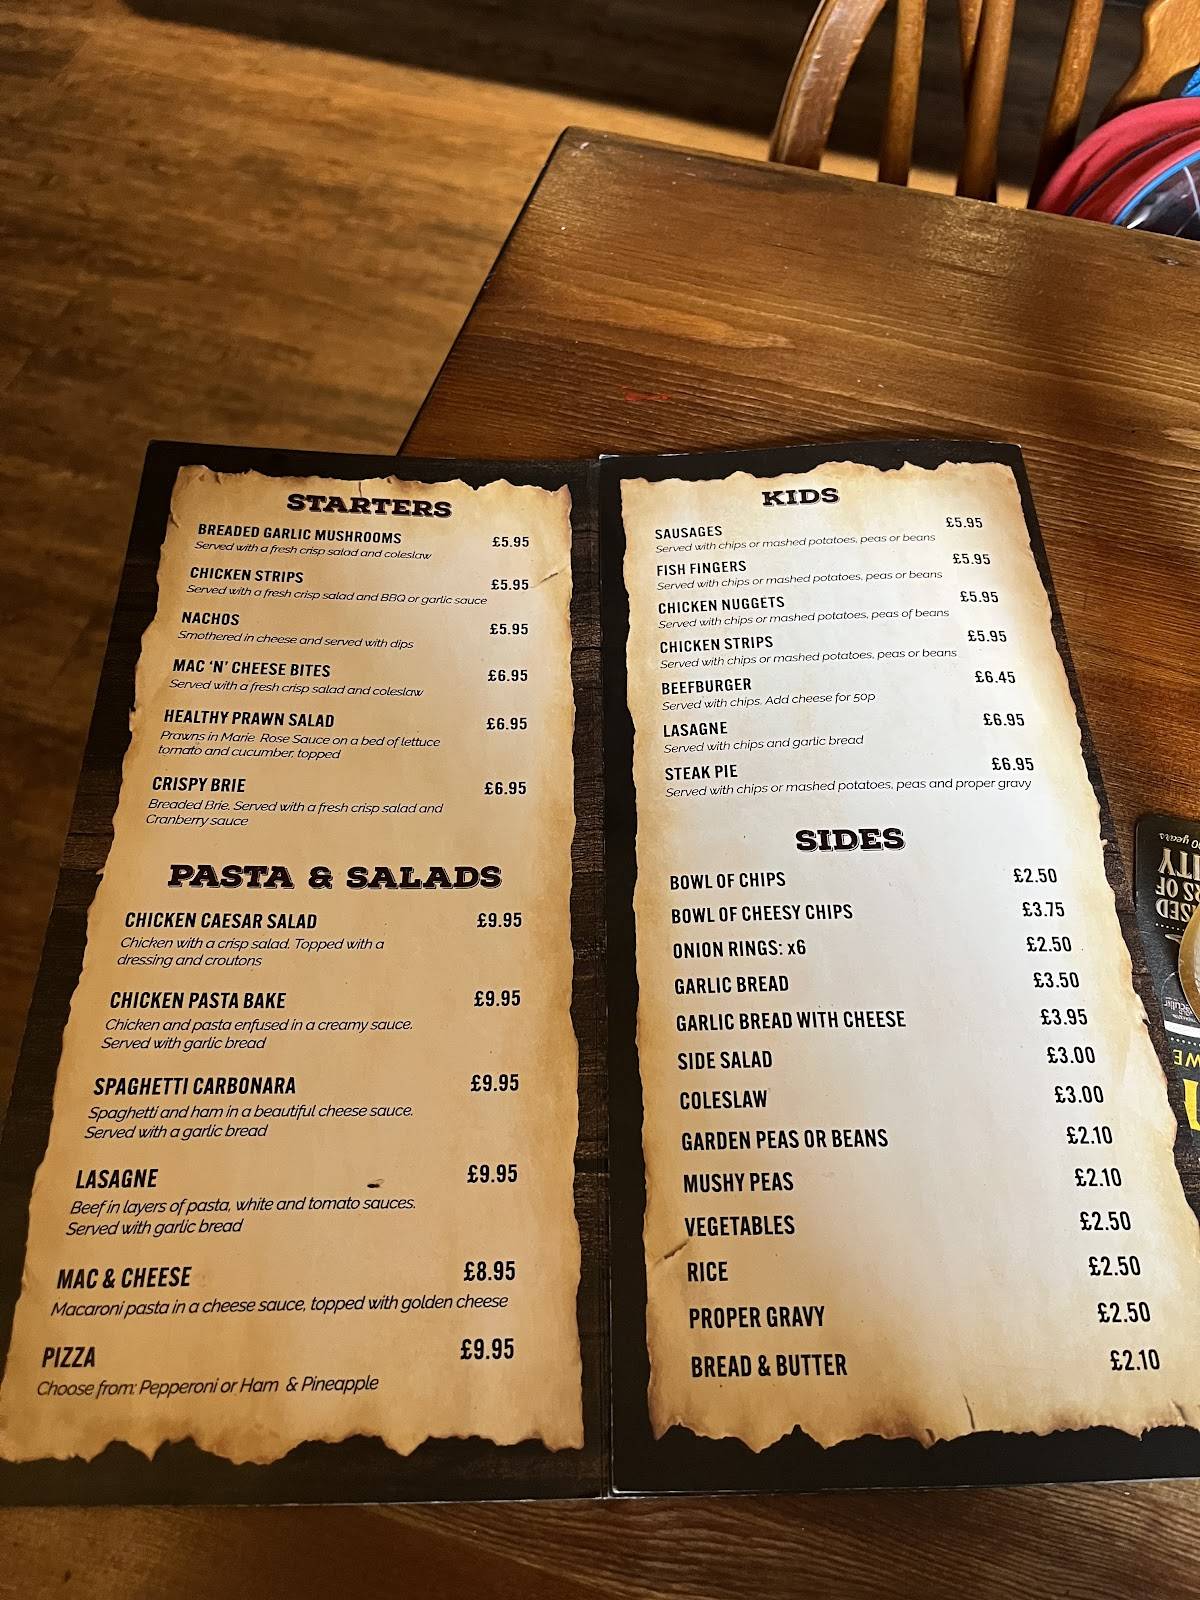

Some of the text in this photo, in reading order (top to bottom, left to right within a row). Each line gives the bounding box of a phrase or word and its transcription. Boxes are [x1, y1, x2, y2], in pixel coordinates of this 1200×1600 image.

[287, 493, 452, 518] STARTERS
[761, 487, 838, 506] KIDS
[198, 523, 401, 544] BREADED GARLIC MUSHROOMS
[655, 525, 722, 539] SAUSAGES
[492, 536, 529, 547] £5.95
[190, 566, 303, 583] CHICKEN STRIPS
[657, 560, 746, 576] FISH FINGERS
[491, 579, 528, 590] £5.95
[186, 584, 227, 594] Served
[229, 587, 251, 595] with
[263, 588, 291, 598] fresh
[293, 590, 320, 600] crisp
[322, 591, 355, 600] salad
[356, 593, 379, 601] and
[380, 593, 405, 602] BBQ
[420, 595, 452, 605] garlic
[658, 596, 784, 614] CHICKEN NUGGETS
[181, 611, 239, 625] NACHOS
[658, 619, 697, 628] Served
[699, 617, 721, 626] with
[724, 615, 753, 626] chips
[769, 612, 815, 622] mashed
[871, 611, 899, 620] peas
[901, 608, 913, 619] of
[915, 609, 949, 617] beans
[489, 623, 528, 635] £5.95
[177, 630, 413, 650] Smothered in cheese and served with dips
[172, 659, 205, 672] MAC
[231, 661, 286, 675] CHEESE
[290, 663, 330, 677] BITES
[487, 669, 527, 681] £6.95
[662, 678, 751, 695] BEEFBURGER
[662, 700, 701, 710] Served
[704, 698, 727, 708] with
[764, 694, 789, 704] Add
[791, 694, 832, 703] cheese
[835, 692, 851, 703] for
[853, 693, 875, 702] 50p
[164, 709, 334, 727] HEALTHY PRAWN SALAD
[486, 717, 527, 730] £6.95
[663, 721, 727, 737] LASAGNE
[160, 730, 205, 744] Prawns
[207, 731, 218, 741] in
[220, 732, 255, 742] Marie
[259, 733, 290, 743] Rose
[291, 734, 330, 744] Sauce
[360, 736, 385, 745] bed
[386, 736, 400, 748] of
[400, 736, 440, 746] lettuce
[663, 735, 863, 753] Served with chips and garlic bread
[158, 745, 202, 756] tomato
[204, 746, 230, 755] and
[297, 749, 341, 760] topped
[665, 764, 738, 780] STEAK PIE
[152, 776, 246, 792] CRISPY BRIE
[795, 827, 905, 852] SIDES
[1160, 832, 1190, 845] years
[167, 864, 502, 889] PASTA & SALADS
[1155, 876, 1179, 898] OF
[125, 912, 317, 928] CHICKEN CAESAR SALAD
[477, 912, 521, 928] £9.95
[671, 904, 852, 923] BOWL OF CHEESY CHIPS
[673, 939, 806, 958] ONION RINGS: x6
[1026, 936, 1071, 951] £2.50
[674, 975, 788, 994] GARLIC BREAD
[110, 991, 286, 1008] CHICKEN PASTA BAKE
[105, 1018, 412, 1033] Chicken and pasta enfused in a creamy sauce.
[676, 1010, 906, 1031] GARLIC BREAD WITH CHEESE
[678, 1050, 772, 1070] SIDE SALAD
[1047, 1046, 1095, 1063] £3.00
[93, 1077, 295, 1095] SPAGHETTI CARBONARA
[680, 1090, 767, 1109] COLESLAW
[682, 1129, 888, 1150] GARDEN PEAS OR BEANS
[75, 1168, 158, 1188] LASAGNE
[467, 1164, 517, 1183] £9.95
[683, 1172, 793, 1193] MUSHY PEAS
[1075, 1168, 1121, 1186] £2.10
[684, 1215, 794, 1236] VEGETABLES
[57, 1266, 192, 1289] MAC & CHEESE
[687, 1261, 728, 1281] RICE
[689, 1305, 824, 1328] PROPER GRAVY
[1097, 1301, 1150, 1322] £2.50
[42, 1346, 95, 1367] PIZZA
[691, 1353, 847, 1377] BREAD & BUTTER
[37, 1380, 94, 1395] Choose
[139, 1377, 219, 1398] Pepperoni
[220, 1381, 238, 1393] or
[239, 1377, 279, 1392] Ham
[285, 1376, 298, 1391] &
[301, 1374, 379, 1394] Pineapple
